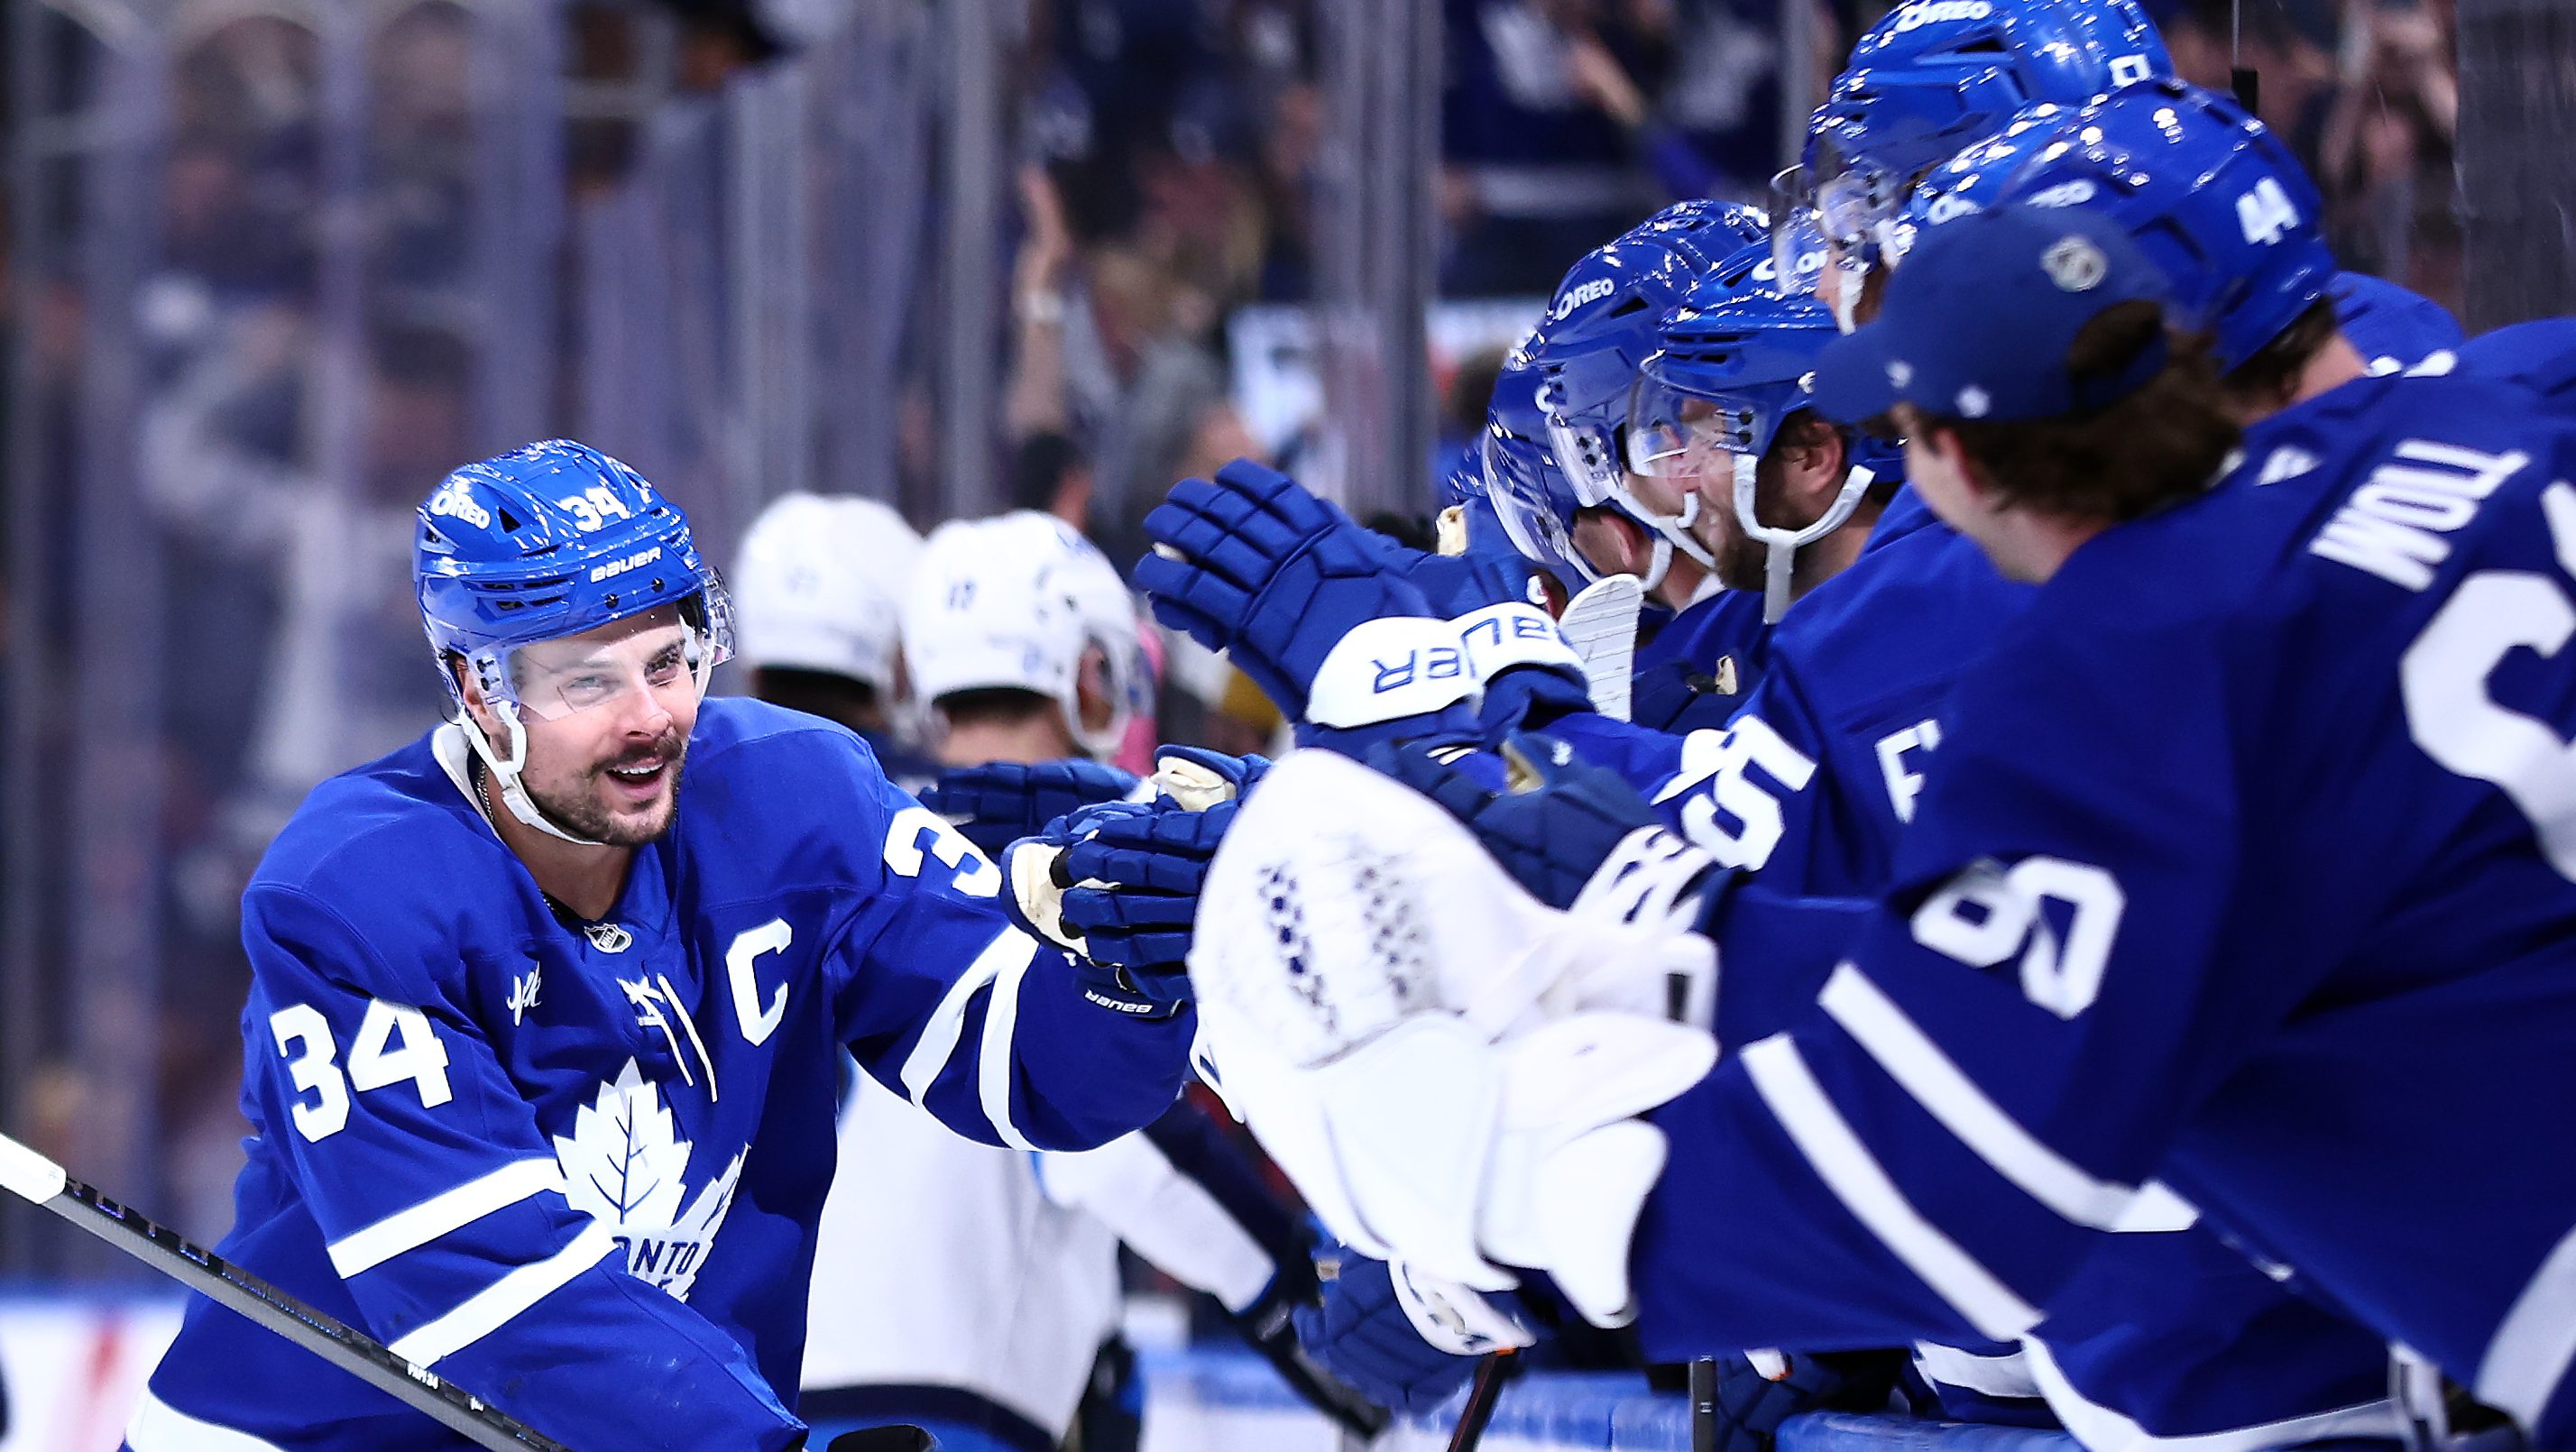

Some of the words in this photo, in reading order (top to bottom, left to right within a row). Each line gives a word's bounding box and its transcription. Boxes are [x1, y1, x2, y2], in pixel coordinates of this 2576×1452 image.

[1554, 277, 1615, 321] OREO
[429, 489, 492, 531] OREO
[560, 486, 630, 532] 34
[2308, 439, 2529, 593] WOLL
[590, 546, 663, 584] BAUER
[1370, 616, 1573, 694] AUER
[725, 916, 793, 1047] C
[1084, 988, 1154, 1013] BAUER
[269, 997, 454, 1144] 34
